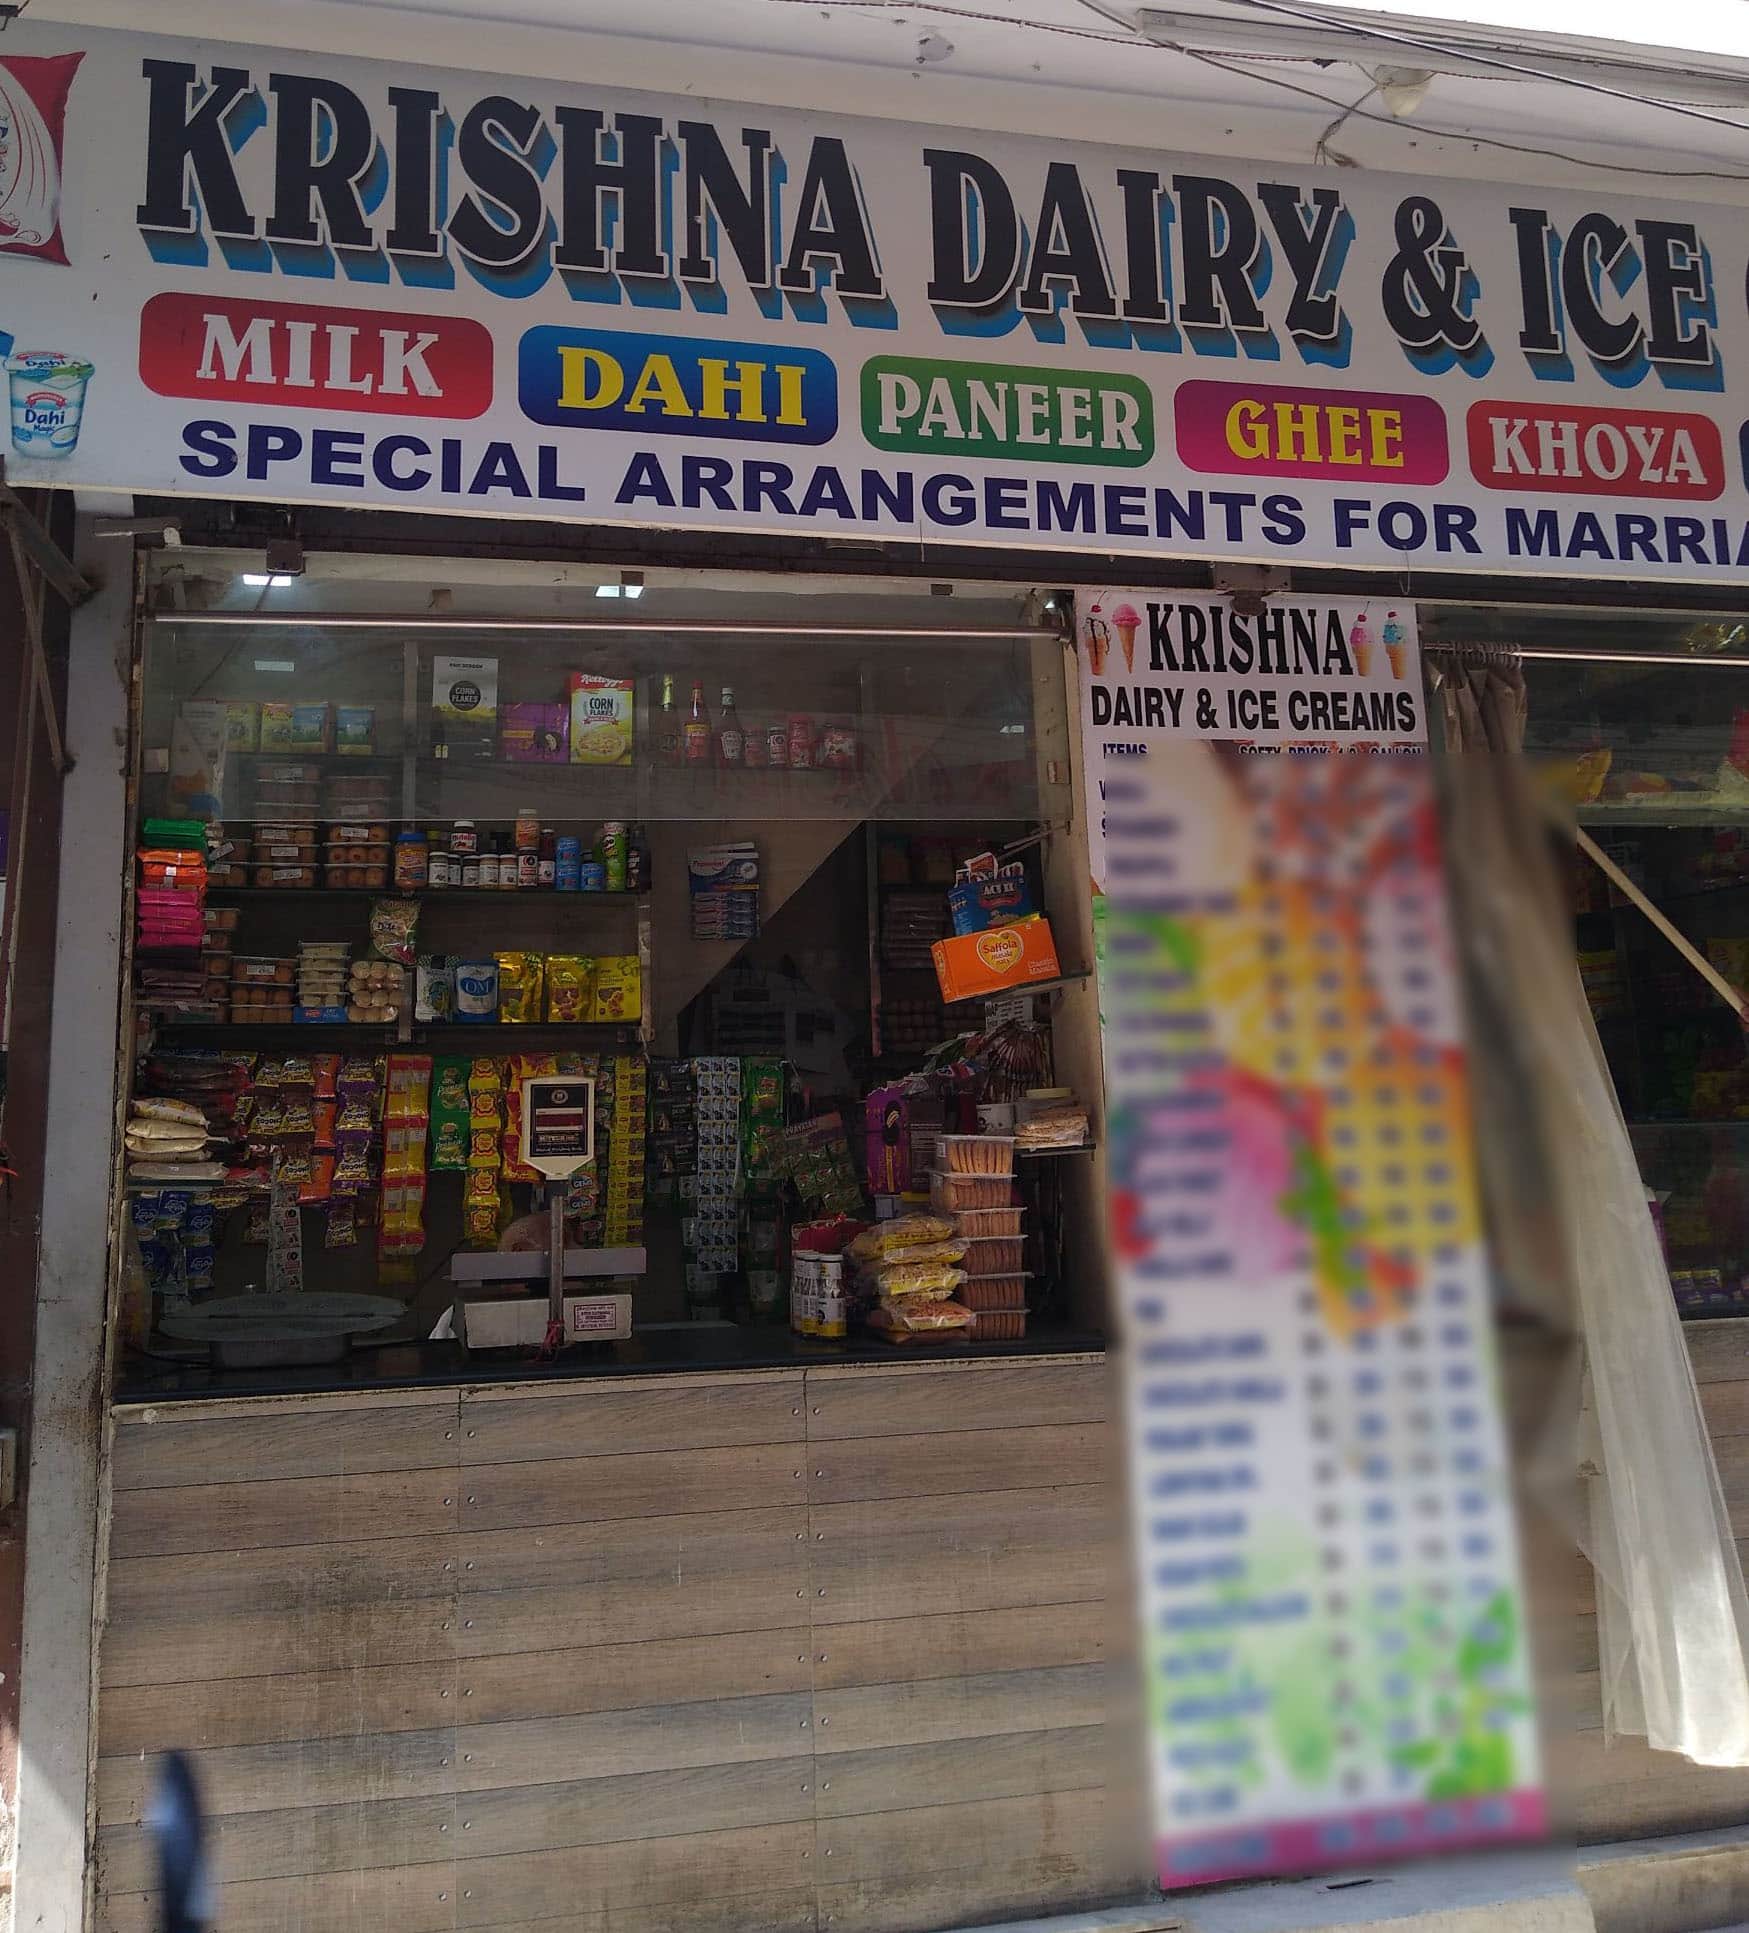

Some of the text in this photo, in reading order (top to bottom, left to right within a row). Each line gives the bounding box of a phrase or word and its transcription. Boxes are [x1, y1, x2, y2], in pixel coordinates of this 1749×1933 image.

[136, 58, 1715, 367] KRISHNA DAIRY & ICE
[195, 313, 444, 398] MILK
[556, 346, 808, 427] DAHI
[25, 409, 65, 425] Dahi
[876, 373, 1143, 452] PANEER
[1225, 399, 1406, 469] GHEE
[1487, 417, 1708, 485] KHOYA
[180, 420, 1749, 567] SPECIAL ARRANGEMENTS FOR MARRI
[1146, 602, 1354, 676] KRISHNA
[451, 694, 479, 704] FLAKES
[455, 687, 477, 695] CORN
[589, 696, 614, 710] CORN
[1091, 685, 1417, 733] DAIRY & ICE CREAMS
[983, 939, 1018, 954] Saffola
